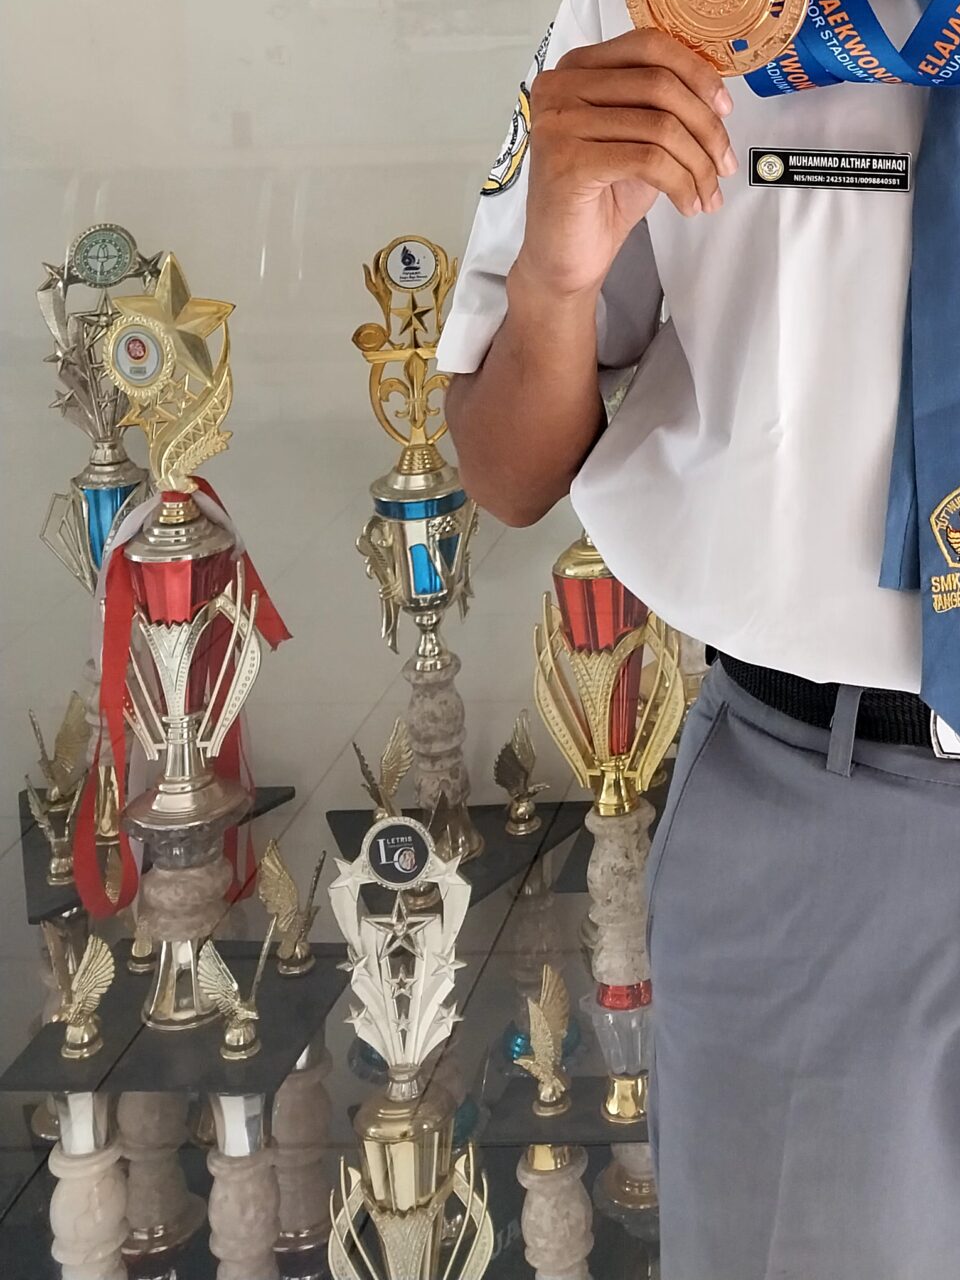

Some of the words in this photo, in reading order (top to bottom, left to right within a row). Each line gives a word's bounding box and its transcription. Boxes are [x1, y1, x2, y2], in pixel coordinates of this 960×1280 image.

[820, 29, 868, 78] STADIUM
[789, 155, 839, 168] MUHAMMAD
[840, 158, 871, 169] ALTHAF
[872, 159, 906, 171] BAIHAQI
[793, 174, 825, 182] NIS/NISN:
[386, 836, 412, 845] LETRIS
